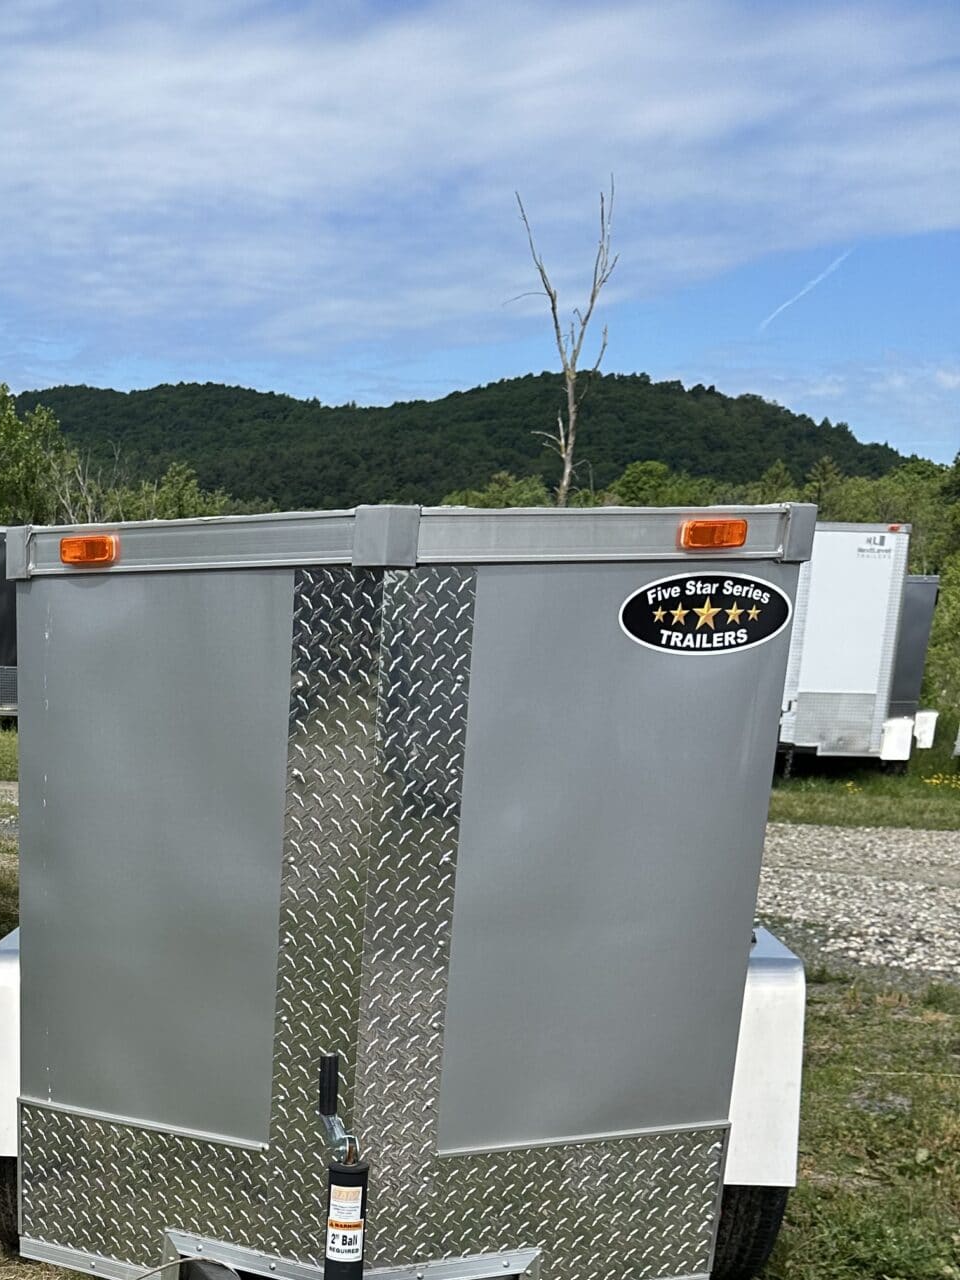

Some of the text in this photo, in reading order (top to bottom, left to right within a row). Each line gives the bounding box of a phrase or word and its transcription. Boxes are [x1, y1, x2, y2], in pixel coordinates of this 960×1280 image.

[646, 580, 771, 606] Five Star Series
[659, 628, 749, 649] TRAILERS
[331, 1232, 358, 1247] 2" Ball
[328, 1246, 360, 1255] REQUIRED
